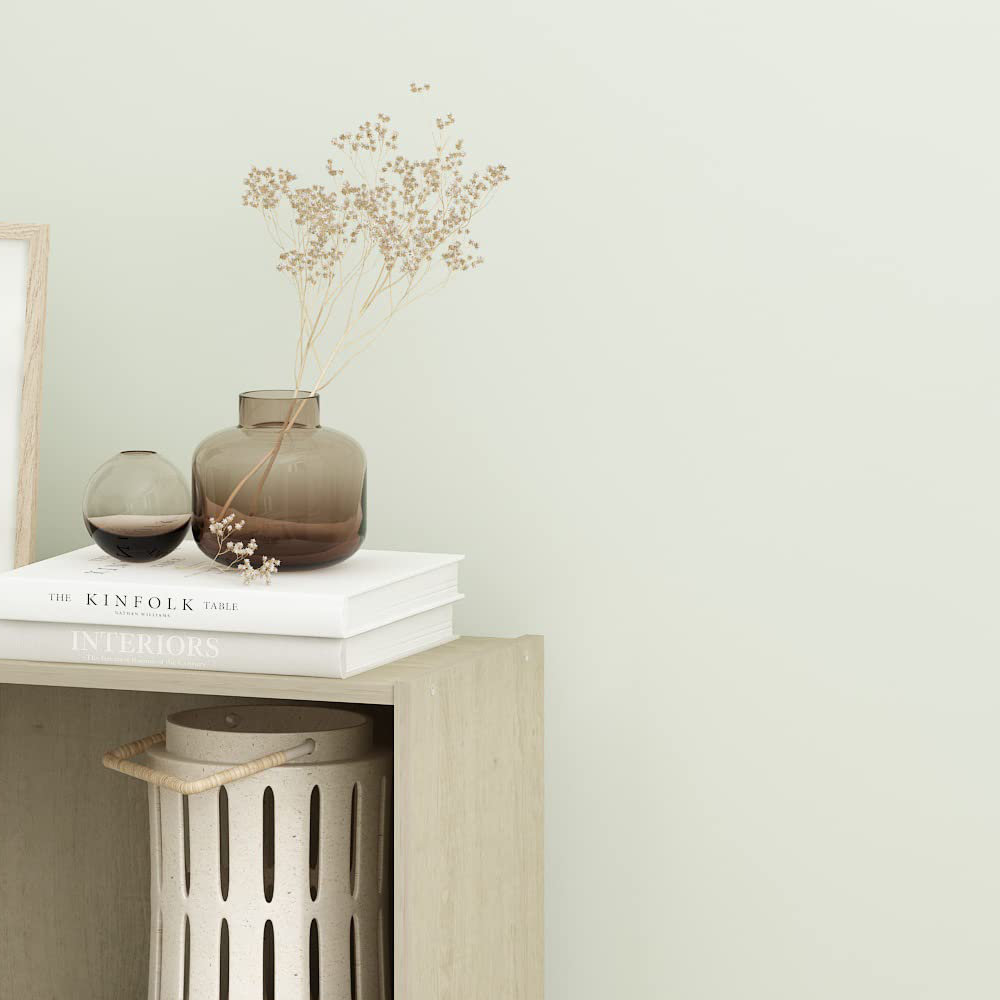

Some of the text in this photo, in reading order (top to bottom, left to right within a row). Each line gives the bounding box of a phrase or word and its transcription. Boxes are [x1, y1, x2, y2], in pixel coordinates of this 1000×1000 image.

[49, 592, 239, 611] THE KINFOLK TABLE
[70, 630, 220, 658] INTERIORS
